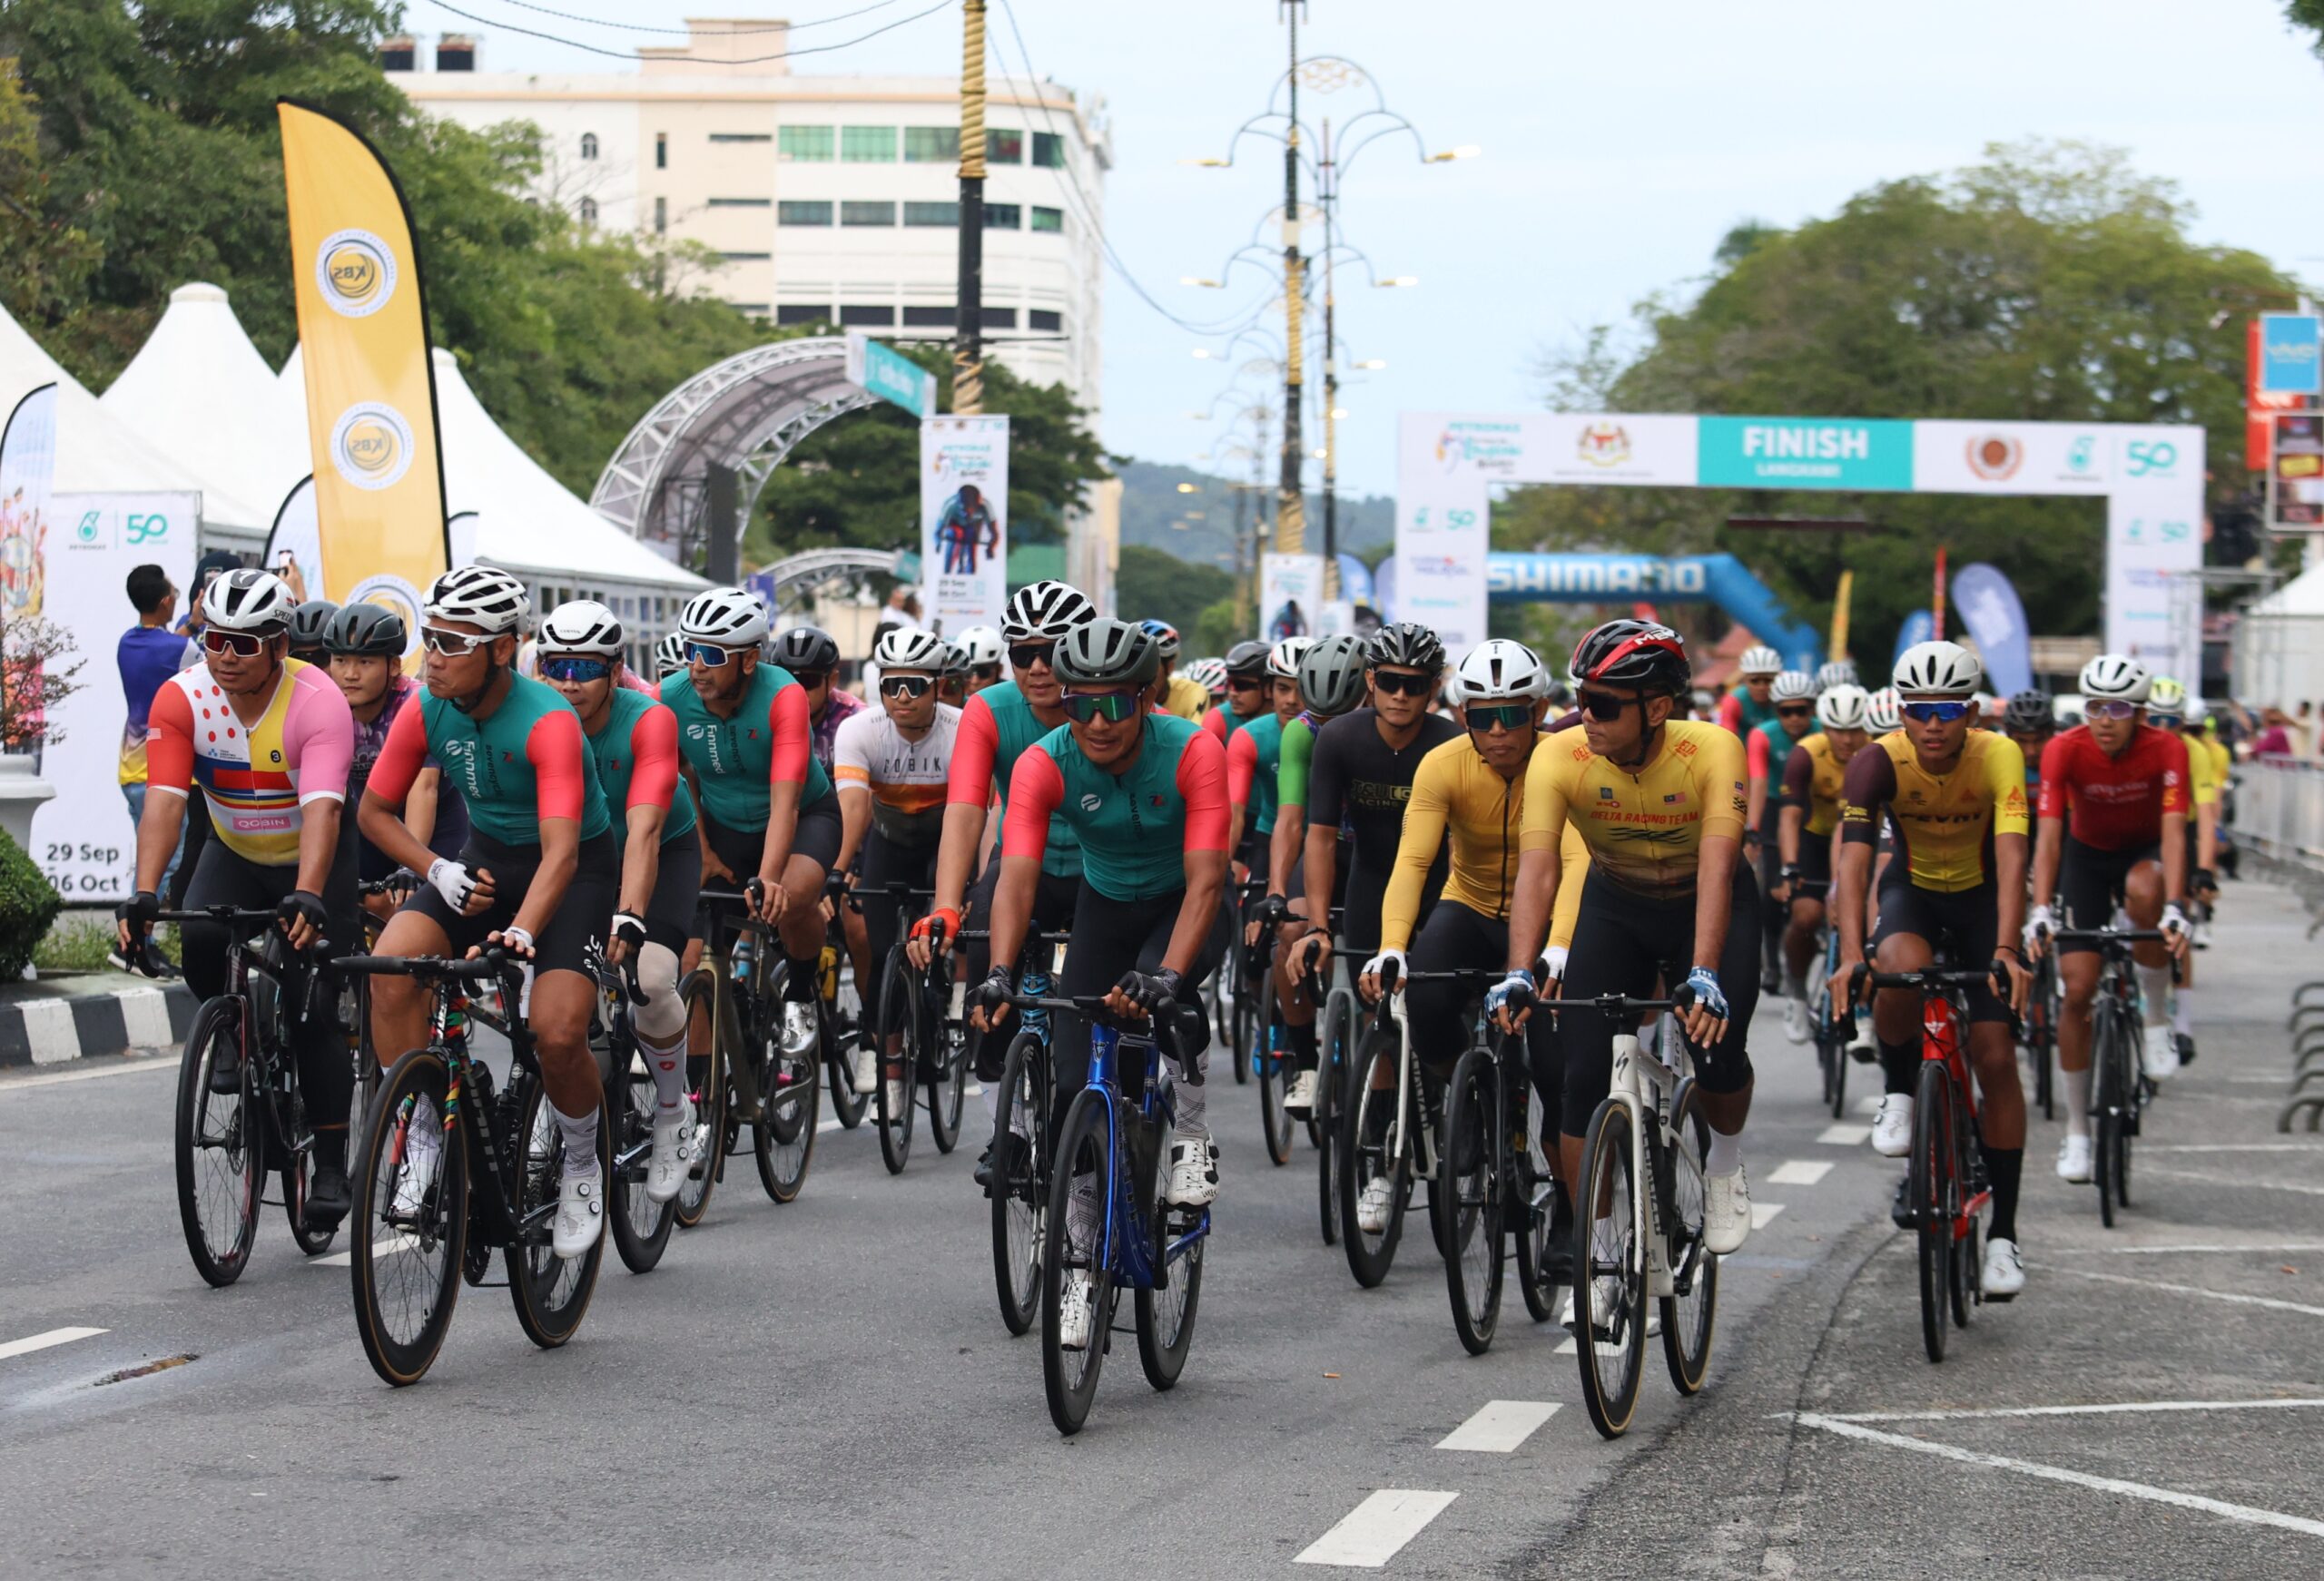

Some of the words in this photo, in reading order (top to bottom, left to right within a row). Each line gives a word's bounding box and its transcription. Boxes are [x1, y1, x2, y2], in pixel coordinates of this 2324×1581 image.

[1743, 427, 1868, 459] FINISH
[2127, 441, 2178, 477] 50
[127, 514, 168, 545] 50
[1590, 810, 1621, 821] DELTA
[1624, 812, 1666, 824] RACING
[1669, 811, 1699, 825] TEAM
[46, 843, 73, 861] 29
[80, 843, 119, 866] Sep
[80, 875, 120, 892] Oct
